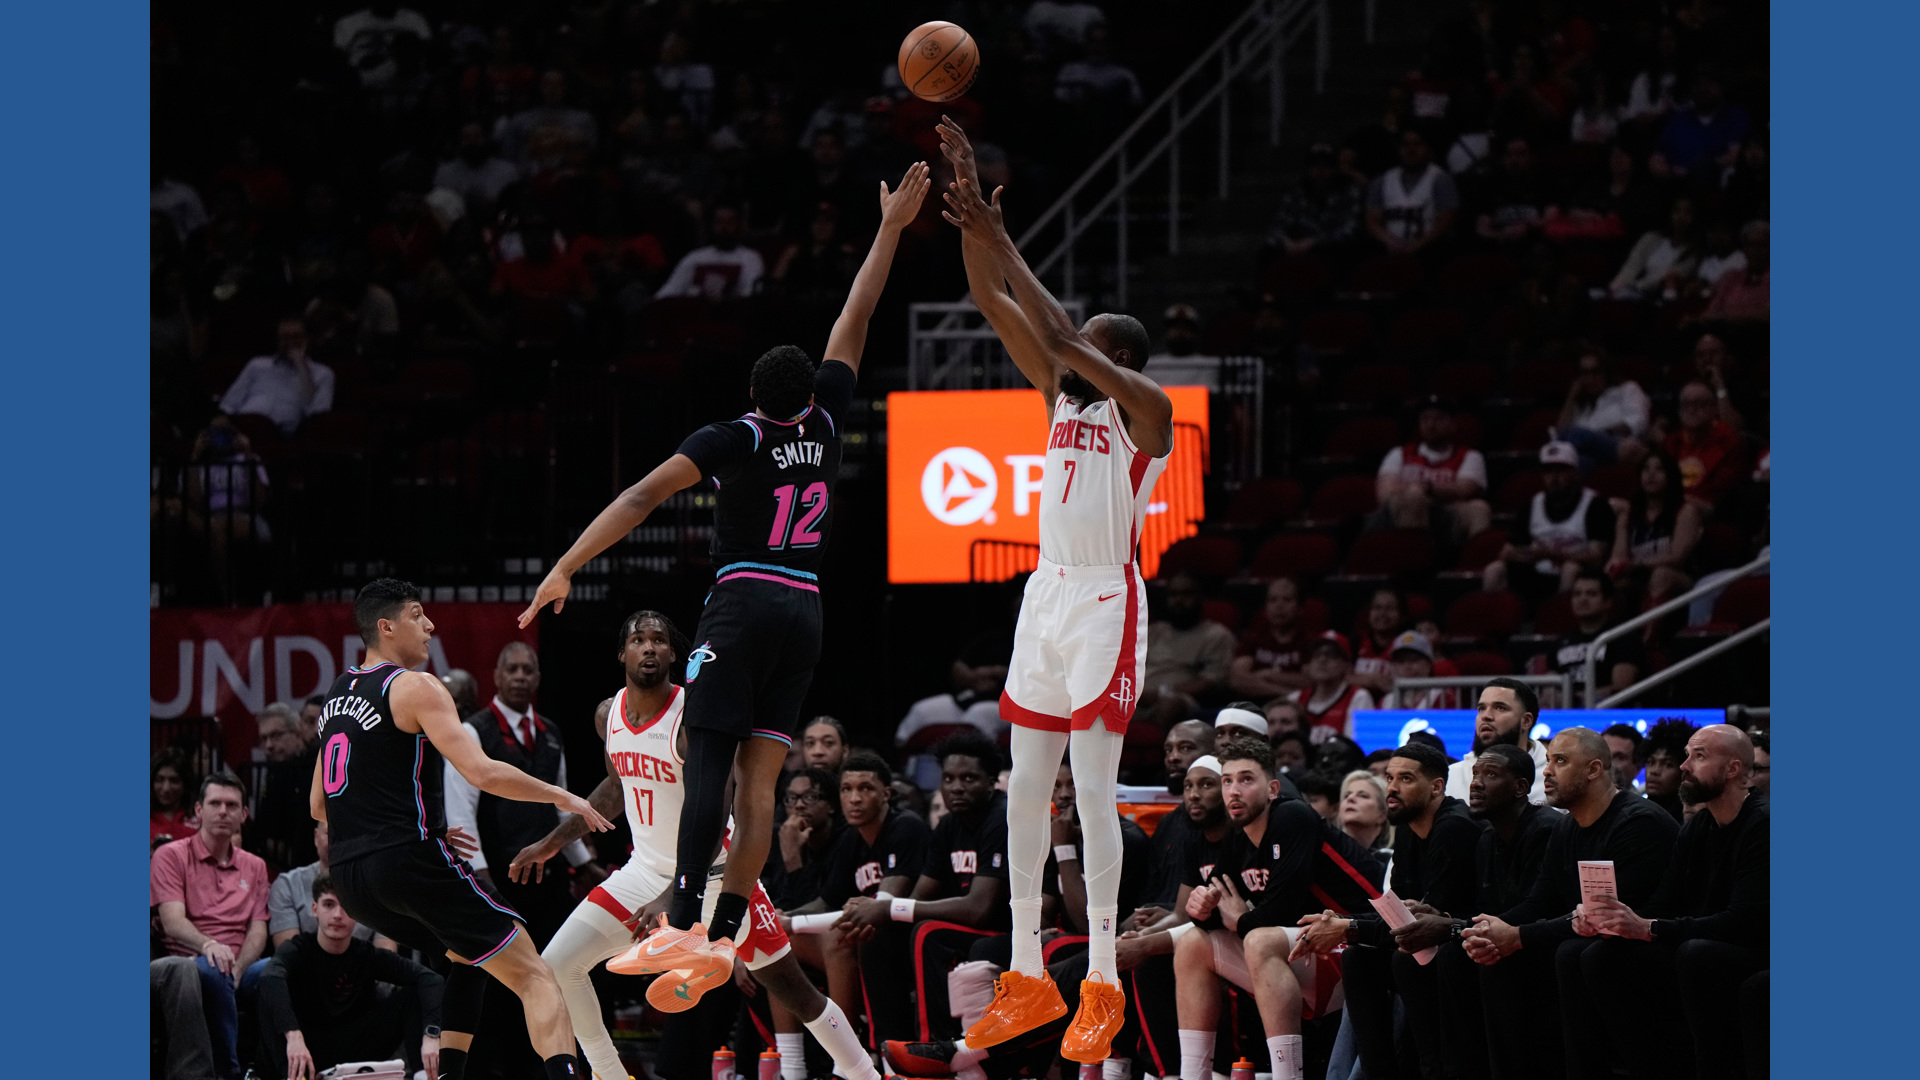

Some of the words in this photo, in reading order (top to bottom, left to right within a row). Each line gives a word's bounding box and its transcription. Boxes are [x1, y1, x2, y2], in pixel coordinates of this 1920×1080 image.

[771, 441, 824, 470] SMITH
[1061, 460, 1077, 504] 7
[767, 481, 829, 551] 12
[317, 695, 382, 740] ONTECCHIO
[323, 732, 351, 798] 0
[632, 786, 653, 826] 17
